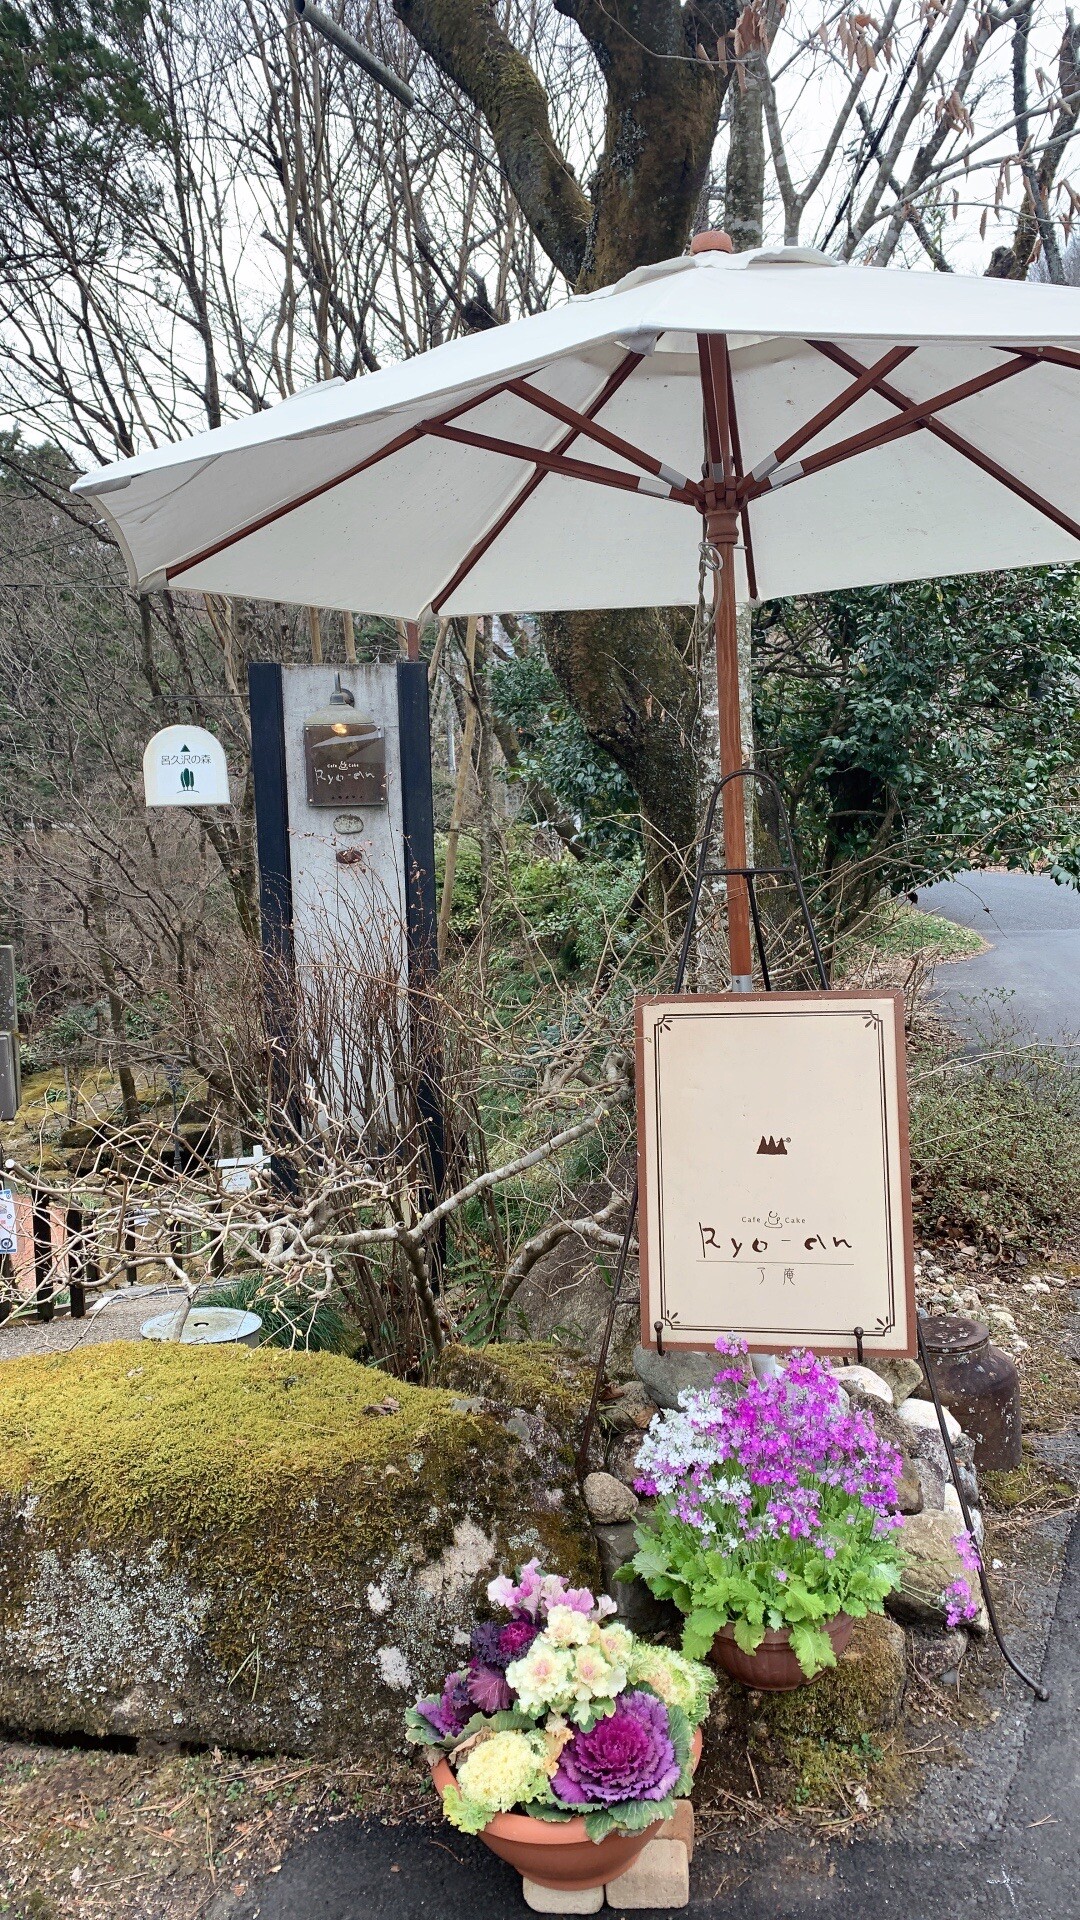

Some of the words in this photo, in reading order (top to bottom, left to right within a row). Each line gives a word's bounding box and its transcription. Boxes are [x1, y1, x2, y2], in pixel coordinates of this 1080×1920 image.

[161, 754, 212, 766] 呂久沢の森
